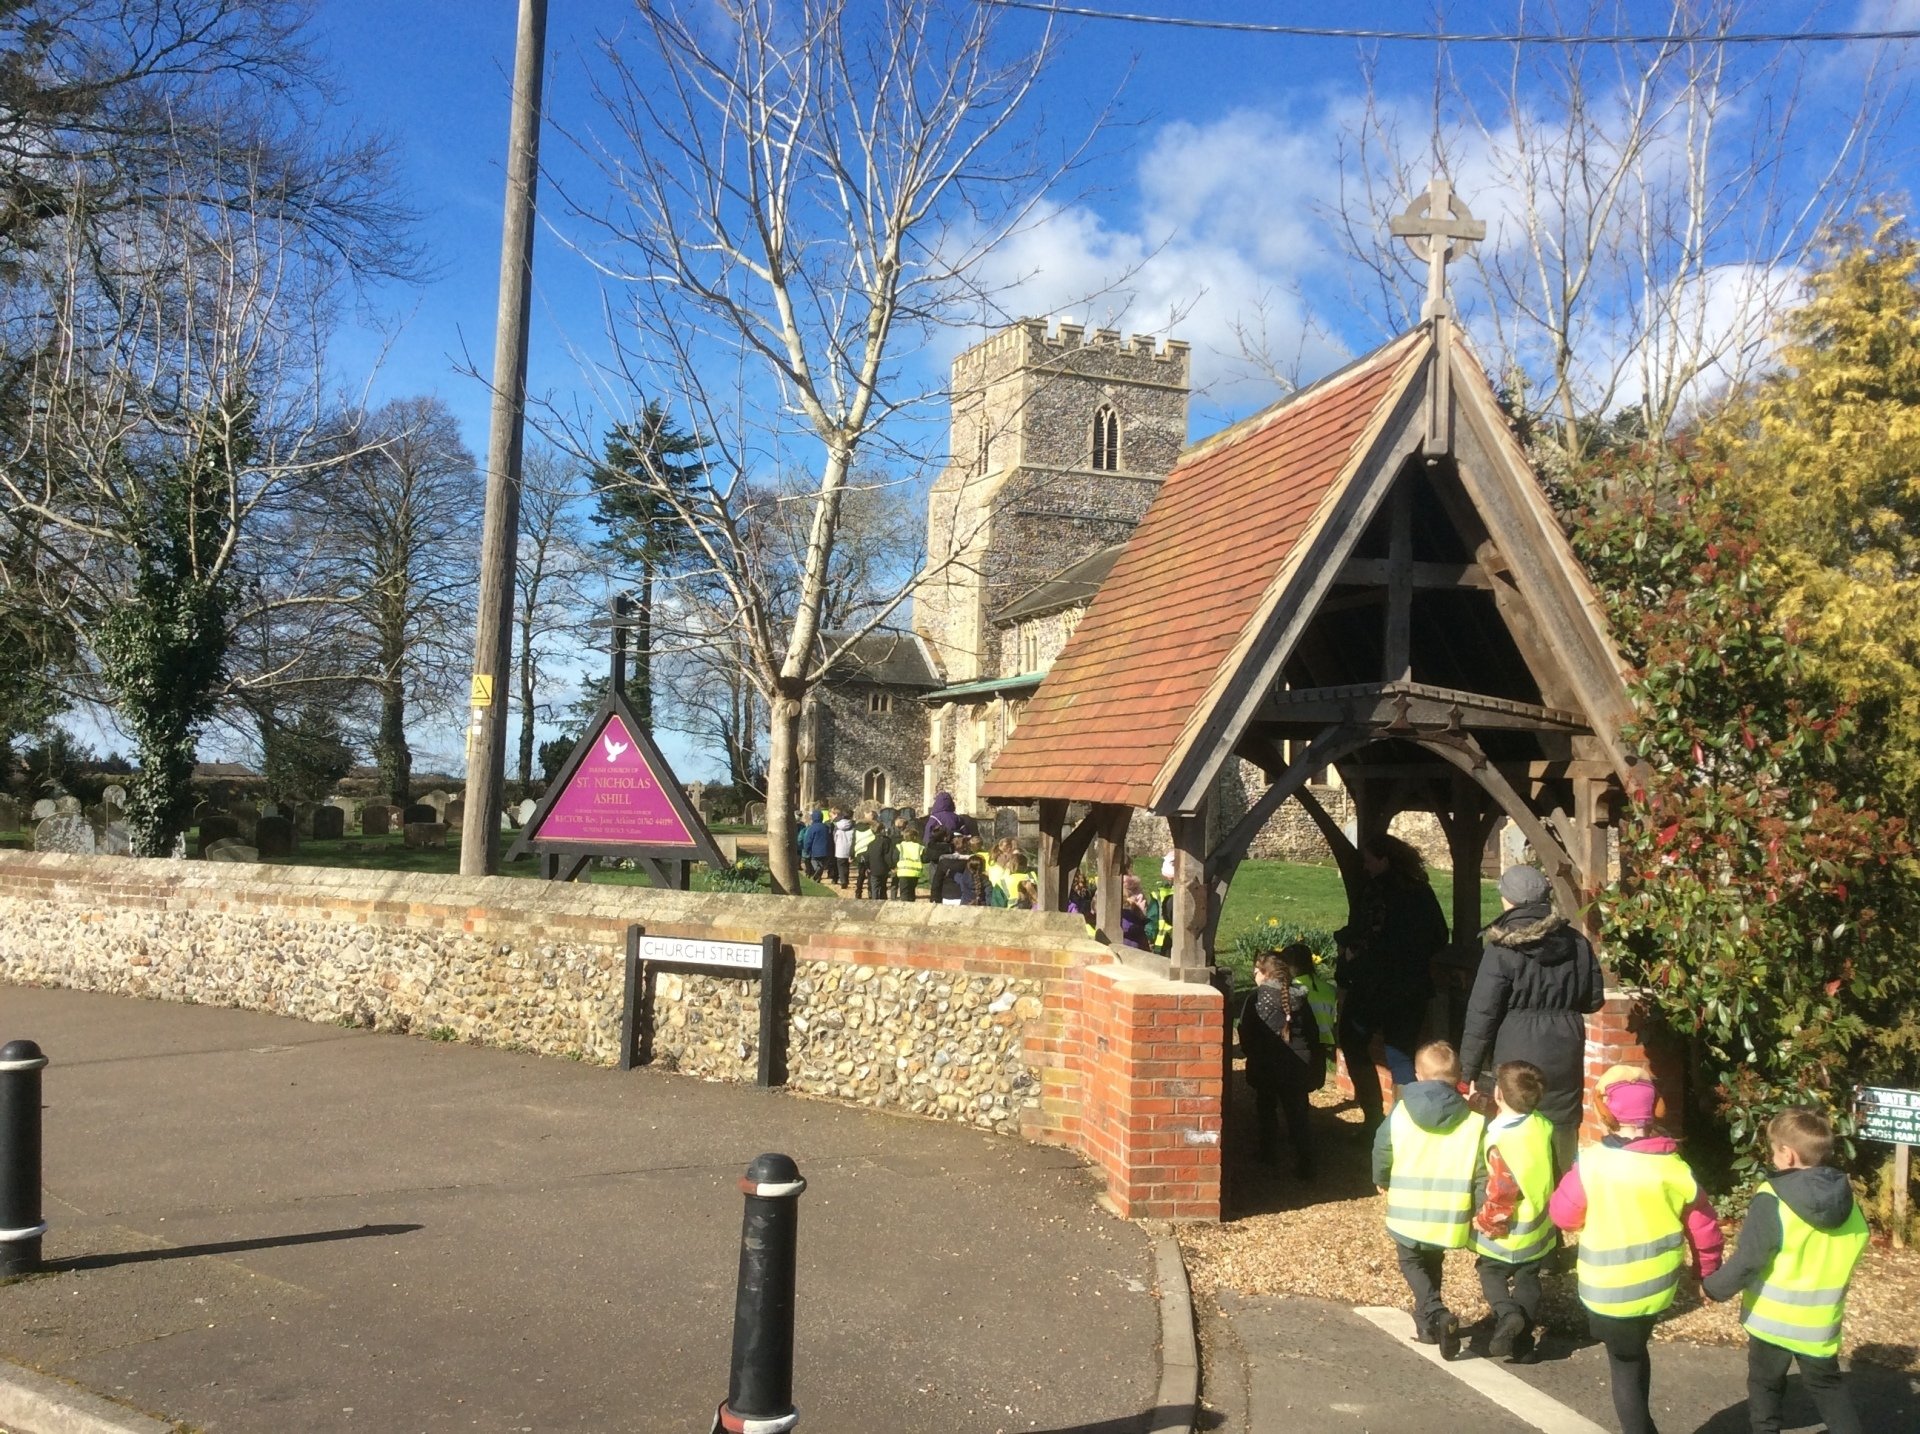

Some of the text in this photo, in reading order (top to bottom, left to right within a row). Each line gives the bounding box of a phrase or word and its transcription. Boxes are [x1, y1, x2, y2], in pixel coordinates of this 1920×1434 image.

[576, 777, 651, 789] ST. NICHOLAS
[593, 793, 632, 805] ASHILL
[555, 814, 583, 823] RECTOR
[643, 941, 760, 964] CHURCH STREET
[1891, 1108, 1914, 1119] KEEP
[1894, 1120, 1913, 1131] CAR
[1894, 1131, 1917, 1143] MAIN
